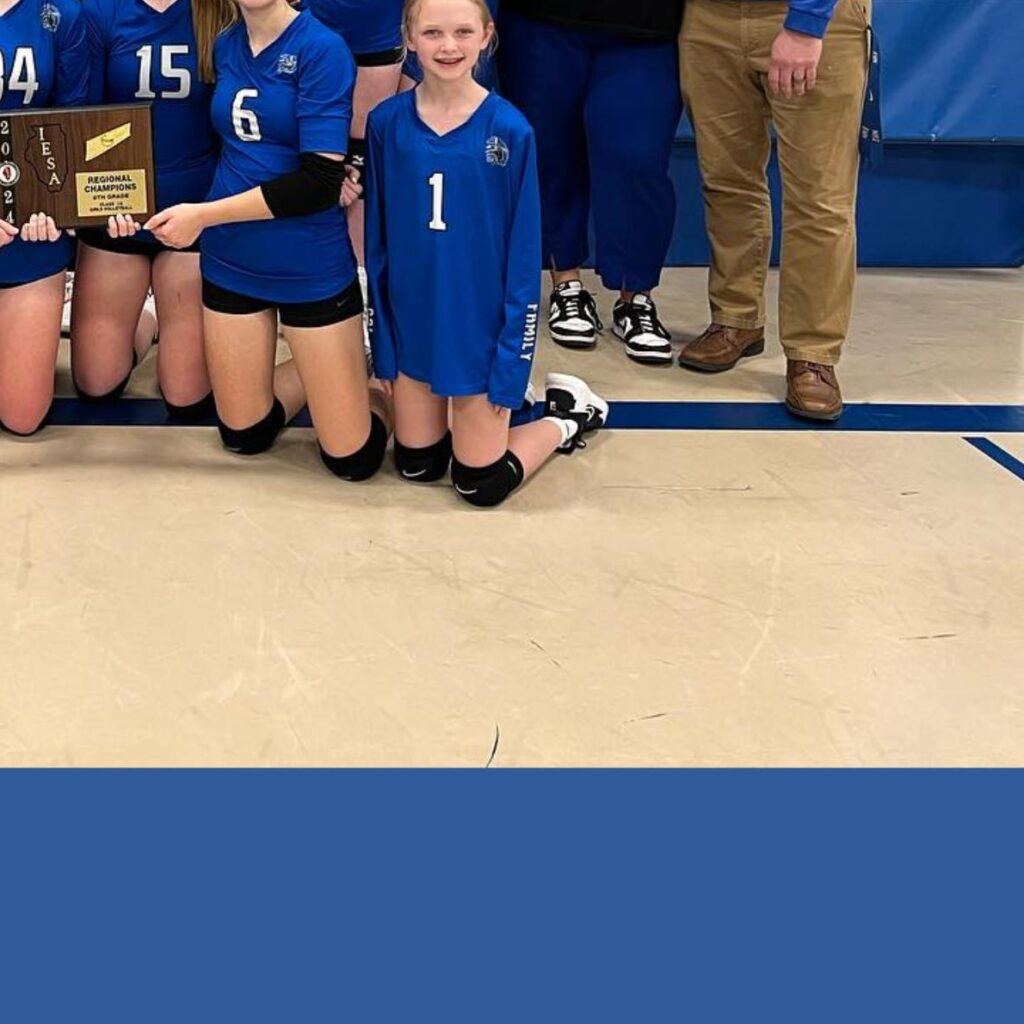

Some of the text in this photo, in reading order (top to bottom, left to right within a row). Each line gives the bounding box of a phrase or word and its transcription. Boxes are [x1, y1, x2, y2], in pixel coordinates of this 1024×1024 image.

[134, 44, 192, 99] 15
[231, 88, 262, 142] 6
[38, 127, 61, 186] IESA
[87, 175, 133, 184] REGIONAL
[84, 183, 137, 193] CHAMPIONS
[428, 173, 447, 231] 1
